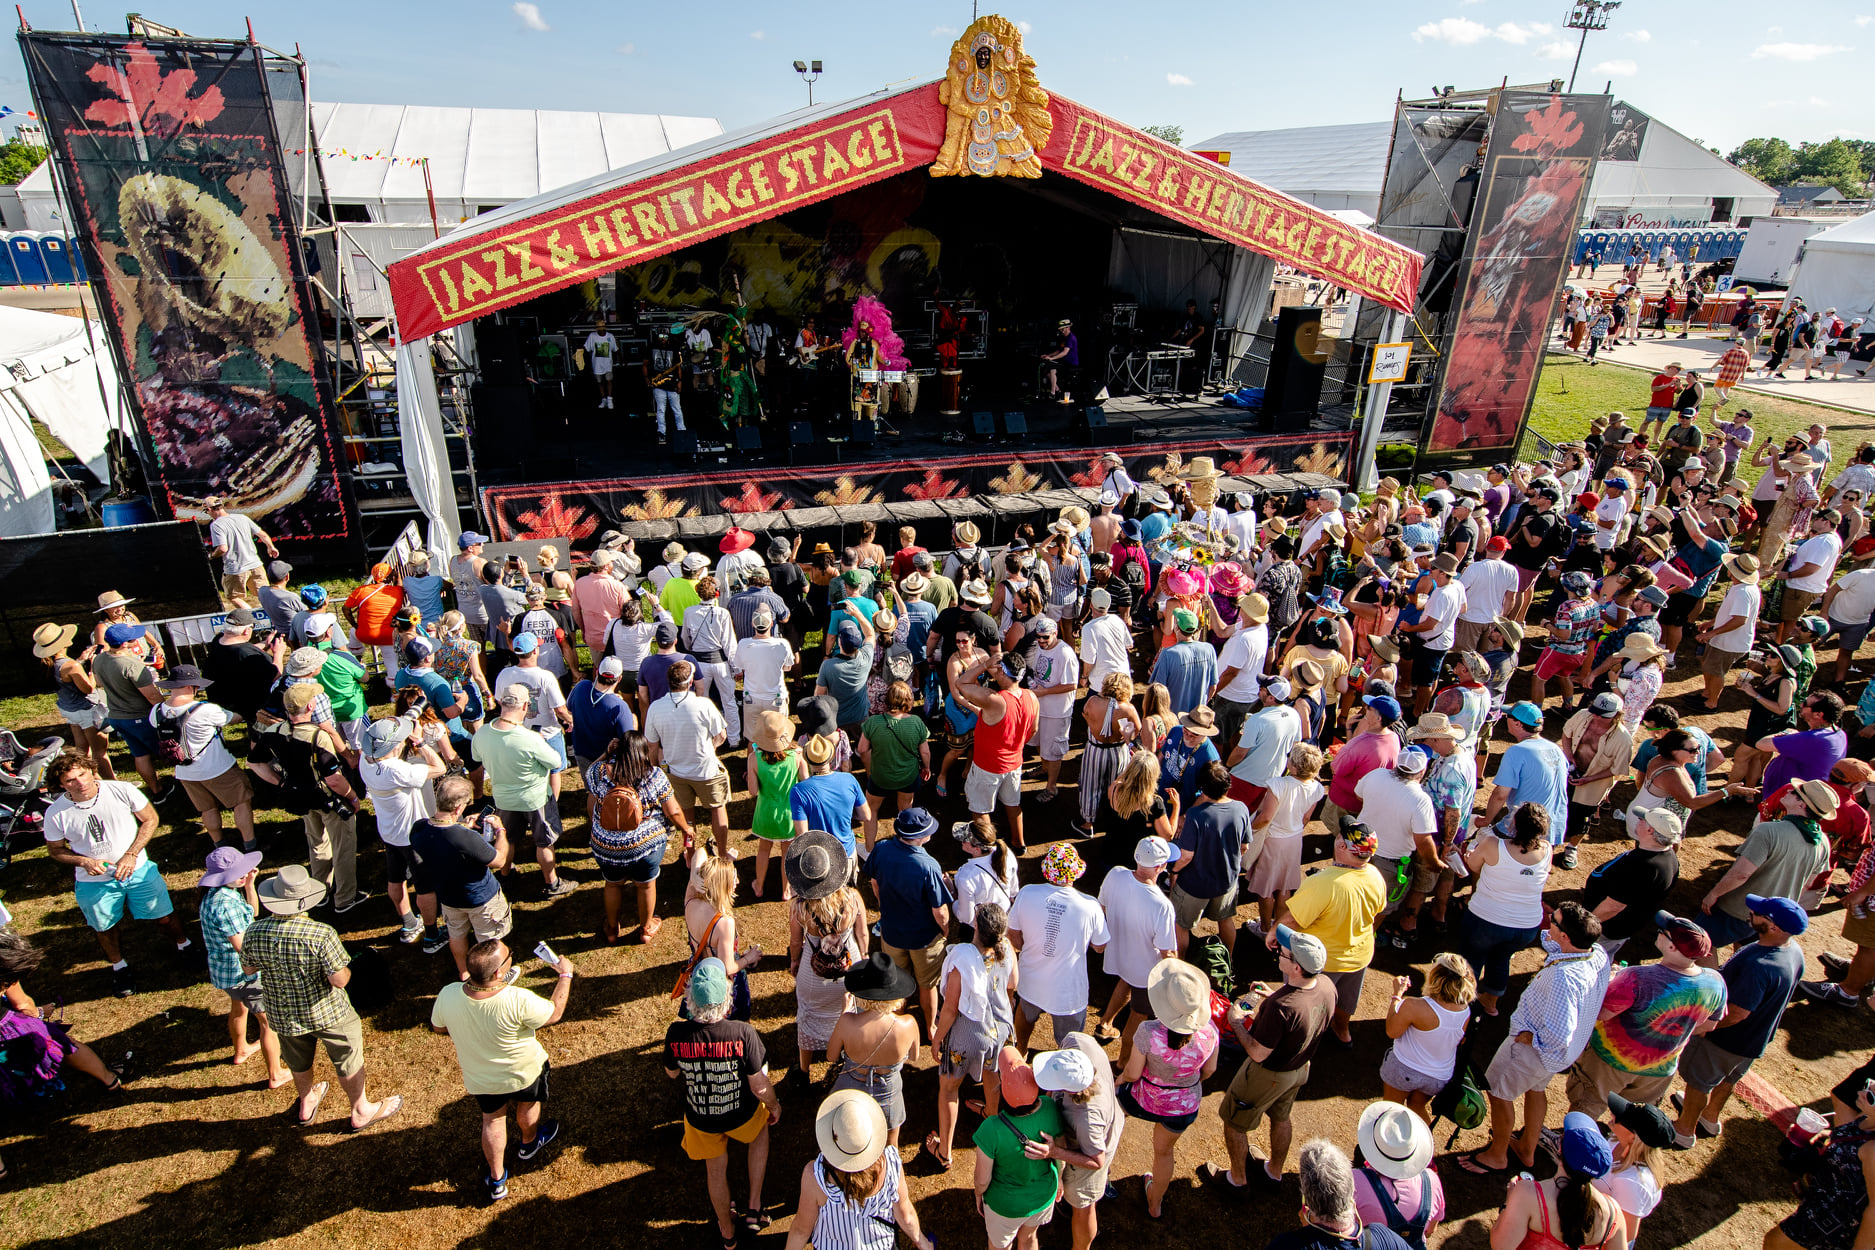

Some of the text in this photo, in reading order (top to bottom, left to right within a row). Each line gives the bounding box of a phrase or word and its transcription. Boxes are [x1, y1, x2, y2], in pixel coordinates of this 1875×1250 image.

[438, 121, 893, 311] JAZZ & HERITAGE STAGE
[1076, 129, 1399, 291] JAZZ & HERITAGE STAGE
[527, 620, 550, 628] FEST
[680, 1042, 707, 1058] ROLLING
[708, 1041, 733, 1058] STONES
[704, 1060, 731, 1072] NOVEMBER
[711, 1081, 737, 1094] DECEMBER
[708, 1092, 734, 1104] DECEMBER
[709, 1103, 734, 1115] DECEMBER
